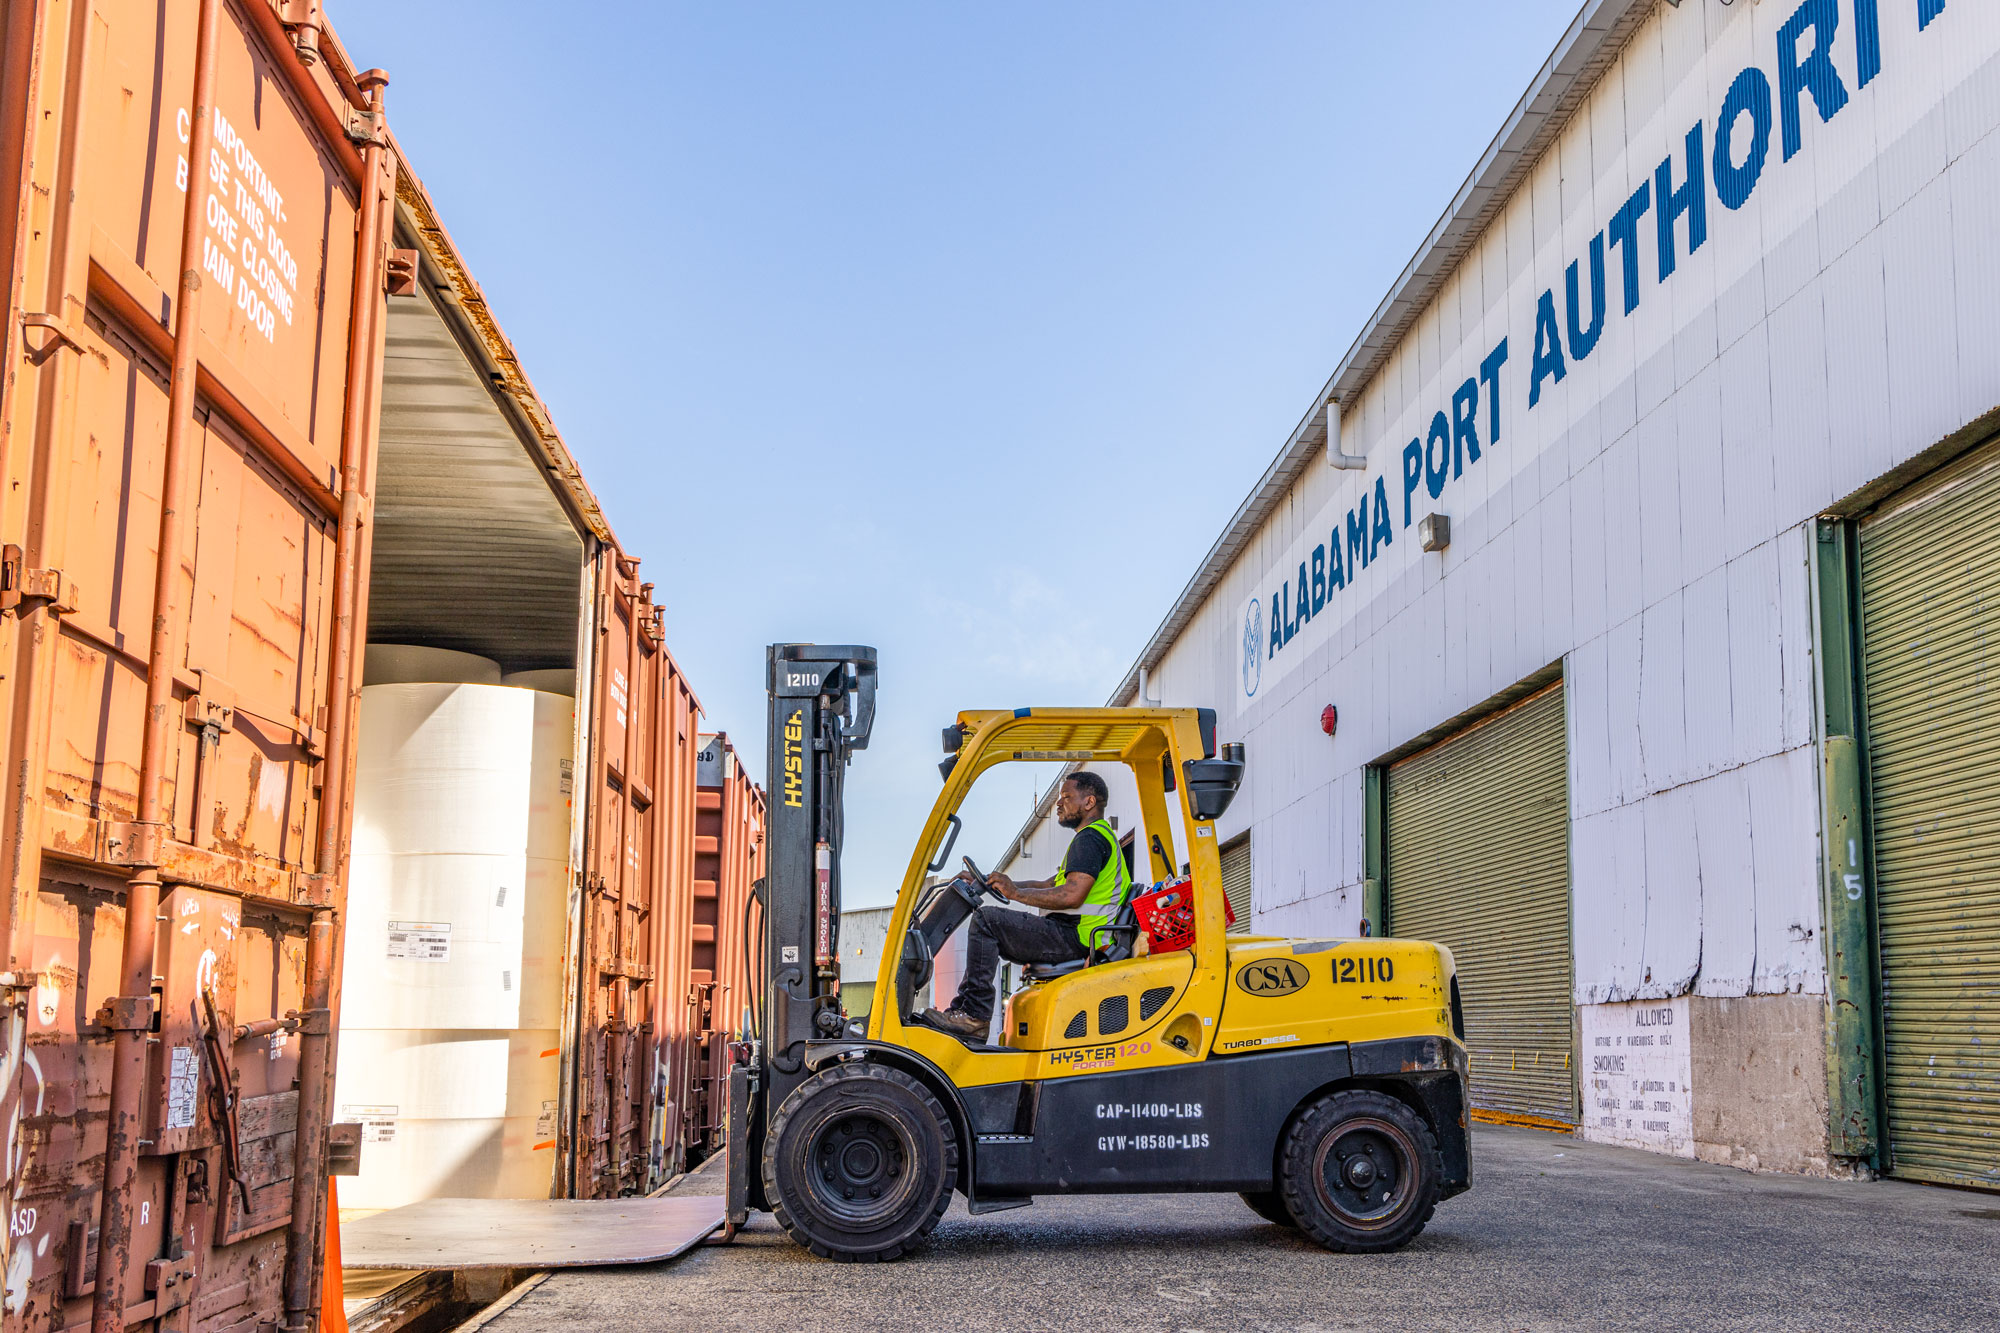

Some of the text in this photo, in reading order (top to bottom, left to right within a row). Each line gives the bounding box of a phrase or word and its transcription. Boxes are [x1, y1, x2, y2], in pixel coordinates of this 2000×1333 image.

[213, 105, 288, 223] MPORTANT-
[176, 106, 298, 292] CSE THIS DOOR
[175, 153, 293, 327] BORE CLOSING
[237, 276, 275, 344] DOOR
[1268, 0, 1949, 661] ALABAMA PORT AUTHORI
[786, 672, 820, 688] 12110
[820, 881, 828, 912] HYDRA
[1243, 963, 1300, 992] CSA
[1331, 956, 1394, 985] 12110
[1635, 1007, 1674, 1027] ALLOWED
[1627, 1034, 1655, 1047] WAREHOUSE
[1050, 1041, 1152, 1065] HYSTER 120
[1072, 1058, 1116, 1071] FORTIS
[1593, 1054, 1625, 1072] SMOKING
[1096, 1102, 1203, 1119] CAP-11400-LBS
[1653, 1101, 1671, 1112] STORED
[1642, 1120, 1669, 1132] WAREHOUSE
[1097, 1133, 1211, 1151] GVW-18580-LBS
[10, 1208, 37, 1238] ASD
[141, 1201, 149, 1225] R
